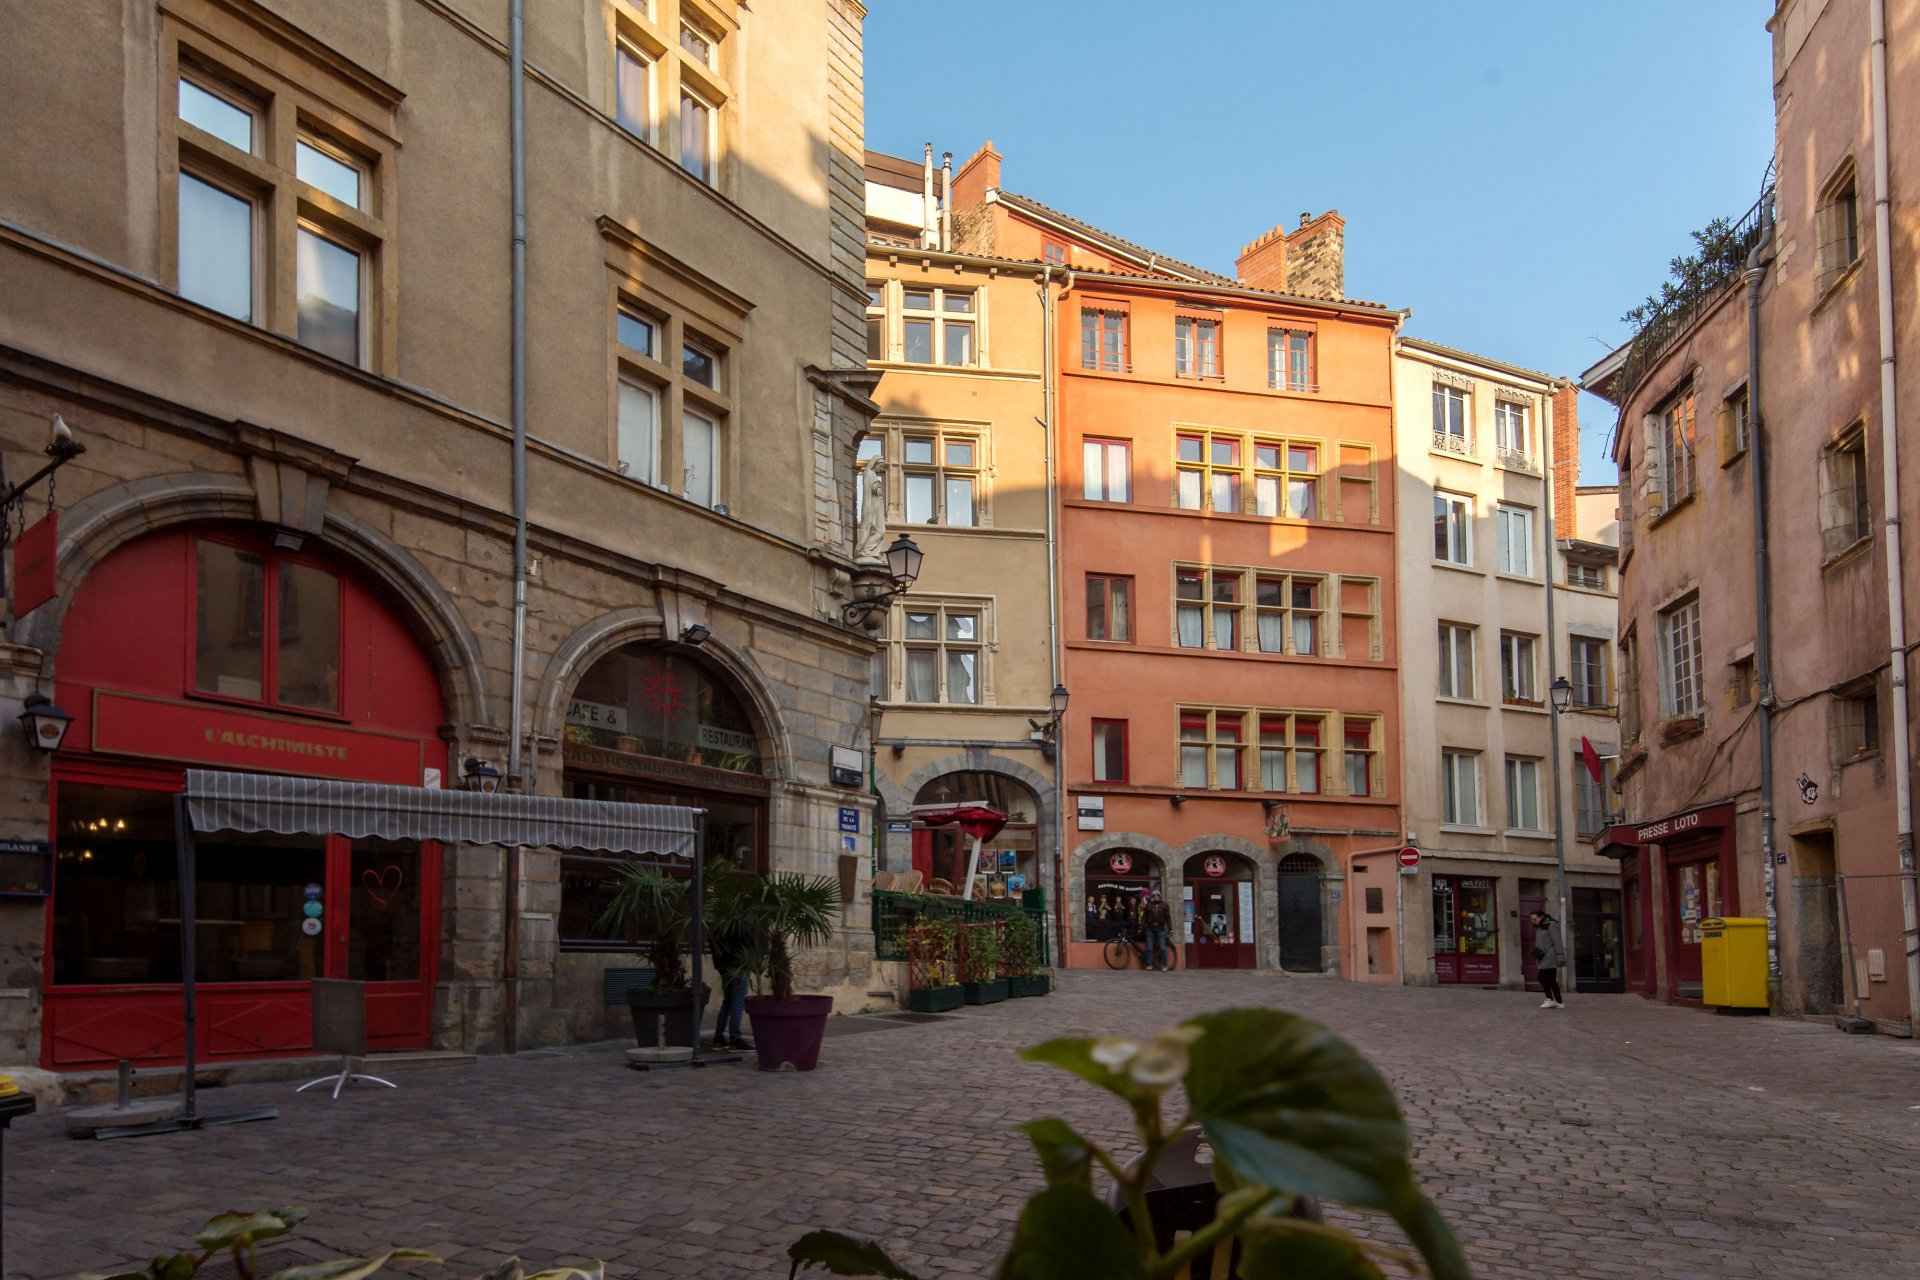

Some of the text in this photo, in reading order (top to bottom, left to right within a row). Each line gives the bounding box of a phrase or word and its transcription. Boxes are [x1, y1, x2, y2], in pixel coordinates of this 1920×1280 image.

[607, 709, 617, 725] &
[1638, 813, 1698, 841] PRESSE LOTO
